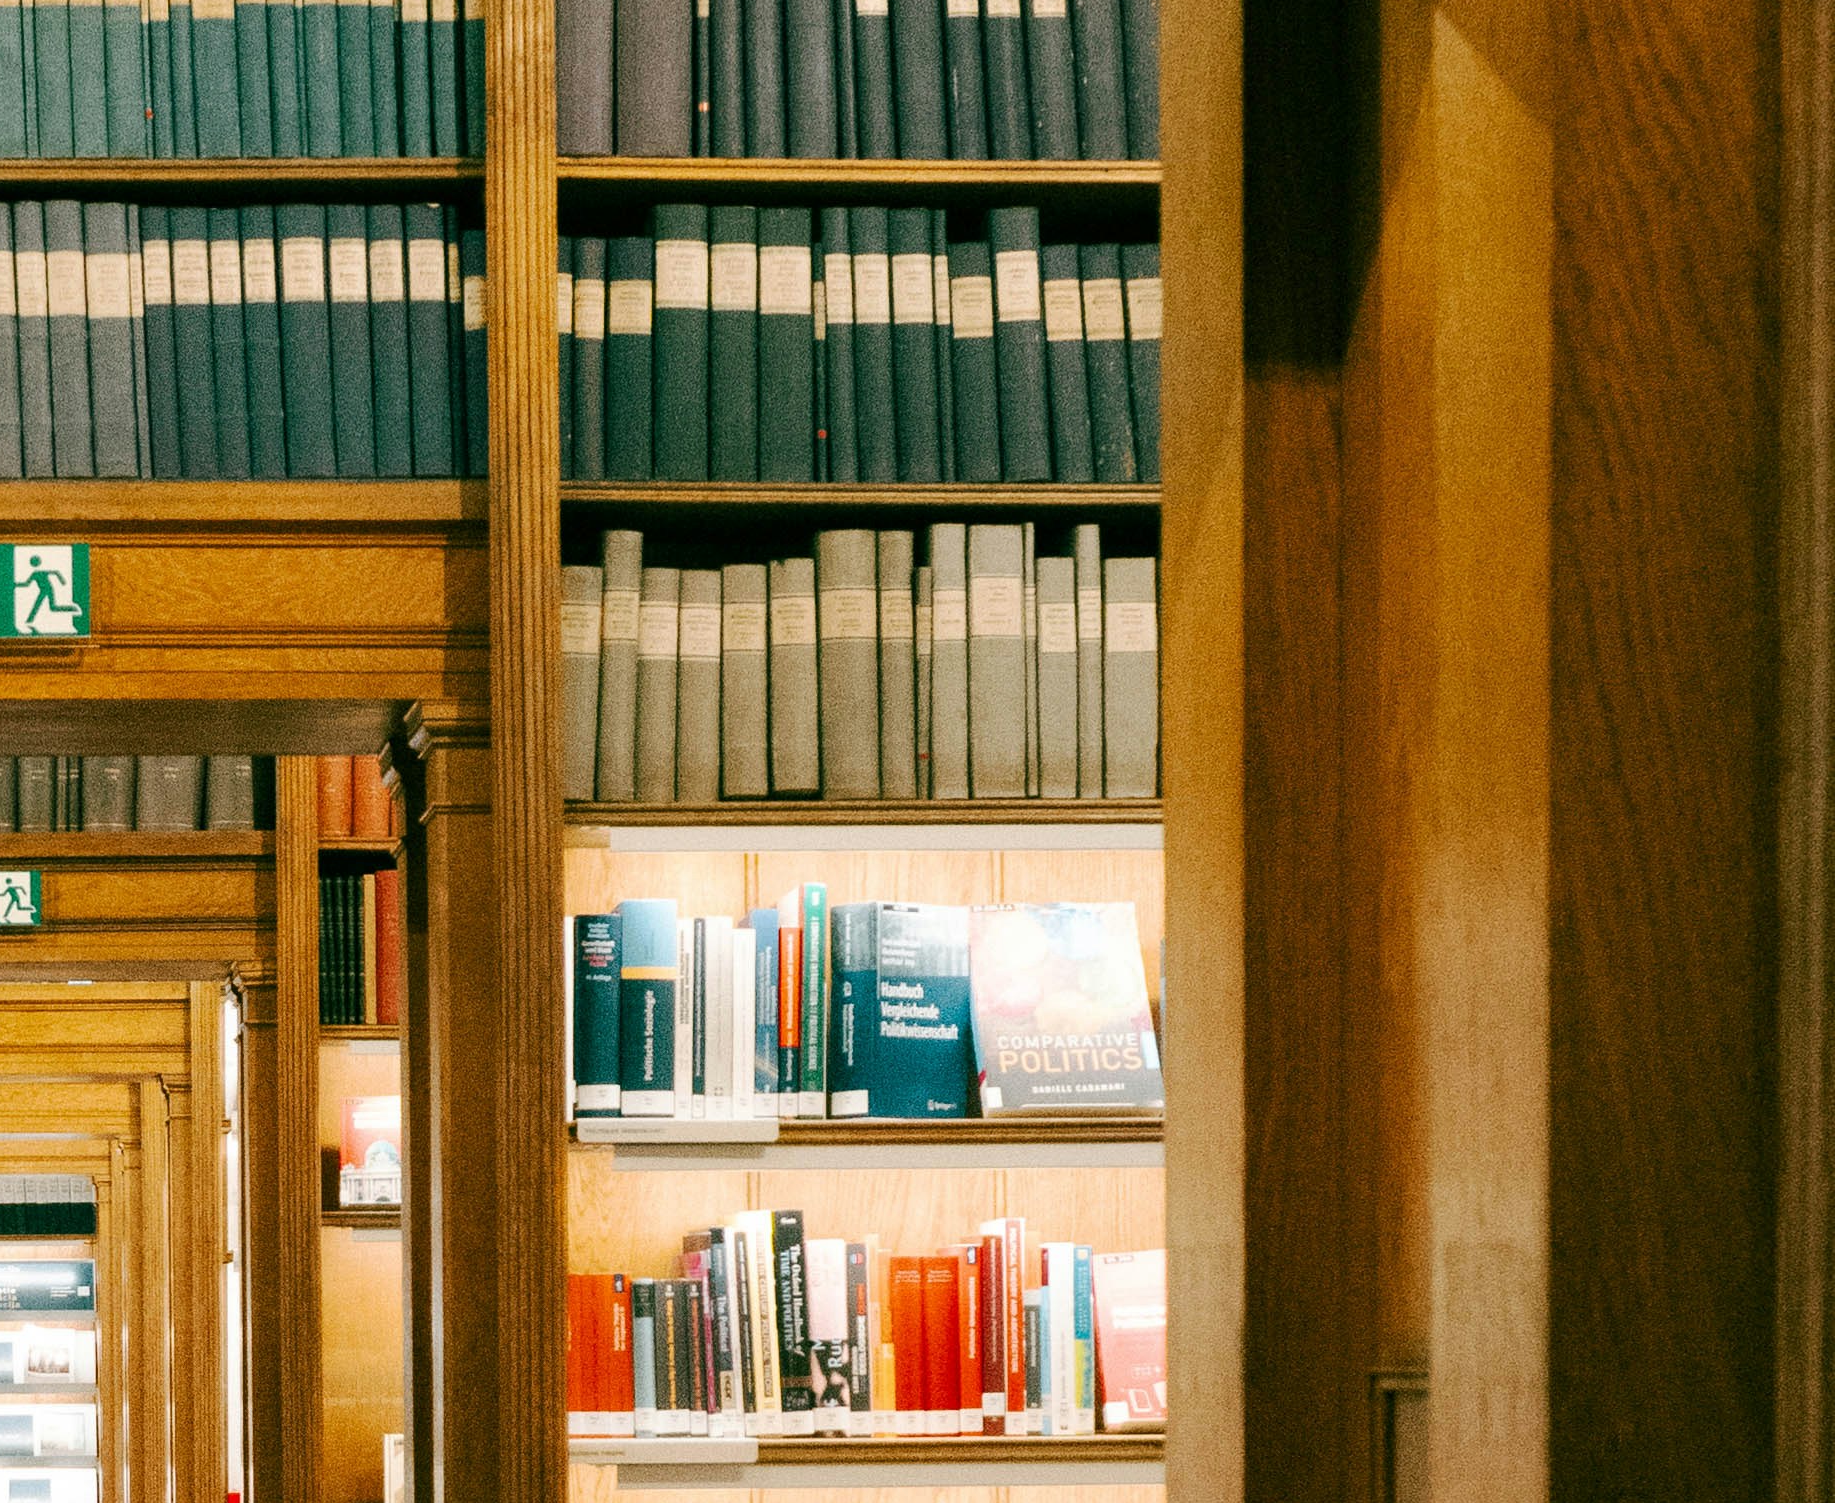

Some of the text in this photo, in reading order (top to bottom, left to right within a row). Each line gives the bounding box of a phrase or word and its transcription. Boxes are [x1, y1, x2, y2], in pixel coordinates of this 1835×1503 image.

[880, 981, 924, 999] Handbuch
[880, 1001, 940, 1021] Vergleichende
[644, 990, 656, 1081] Politische Soziologie
[880, 1021, 959, 1040] Politikwissenschaft
[997, 1033, 1138, 1050] COMPARATIVE
[997, 1049, 1143, 1074] POLITICS
[1032, 1084, 1073, 1094] DANIELE
[790, 1245, 801, 1263] The
[1009, 1227, 1019, 1265] POLITICAL
[791, 1263, 803, 1296] Oxford
[779, 1250, 795, 1352] TIME AND POLITICS
[717, 1296, 732, 1353] The Political
[791, 1297, 804, 1344] Handbook
[1010, 1317, 1019, 1373] ARCHITECTURE
[763, 1364, 773, 1397] THEORY
